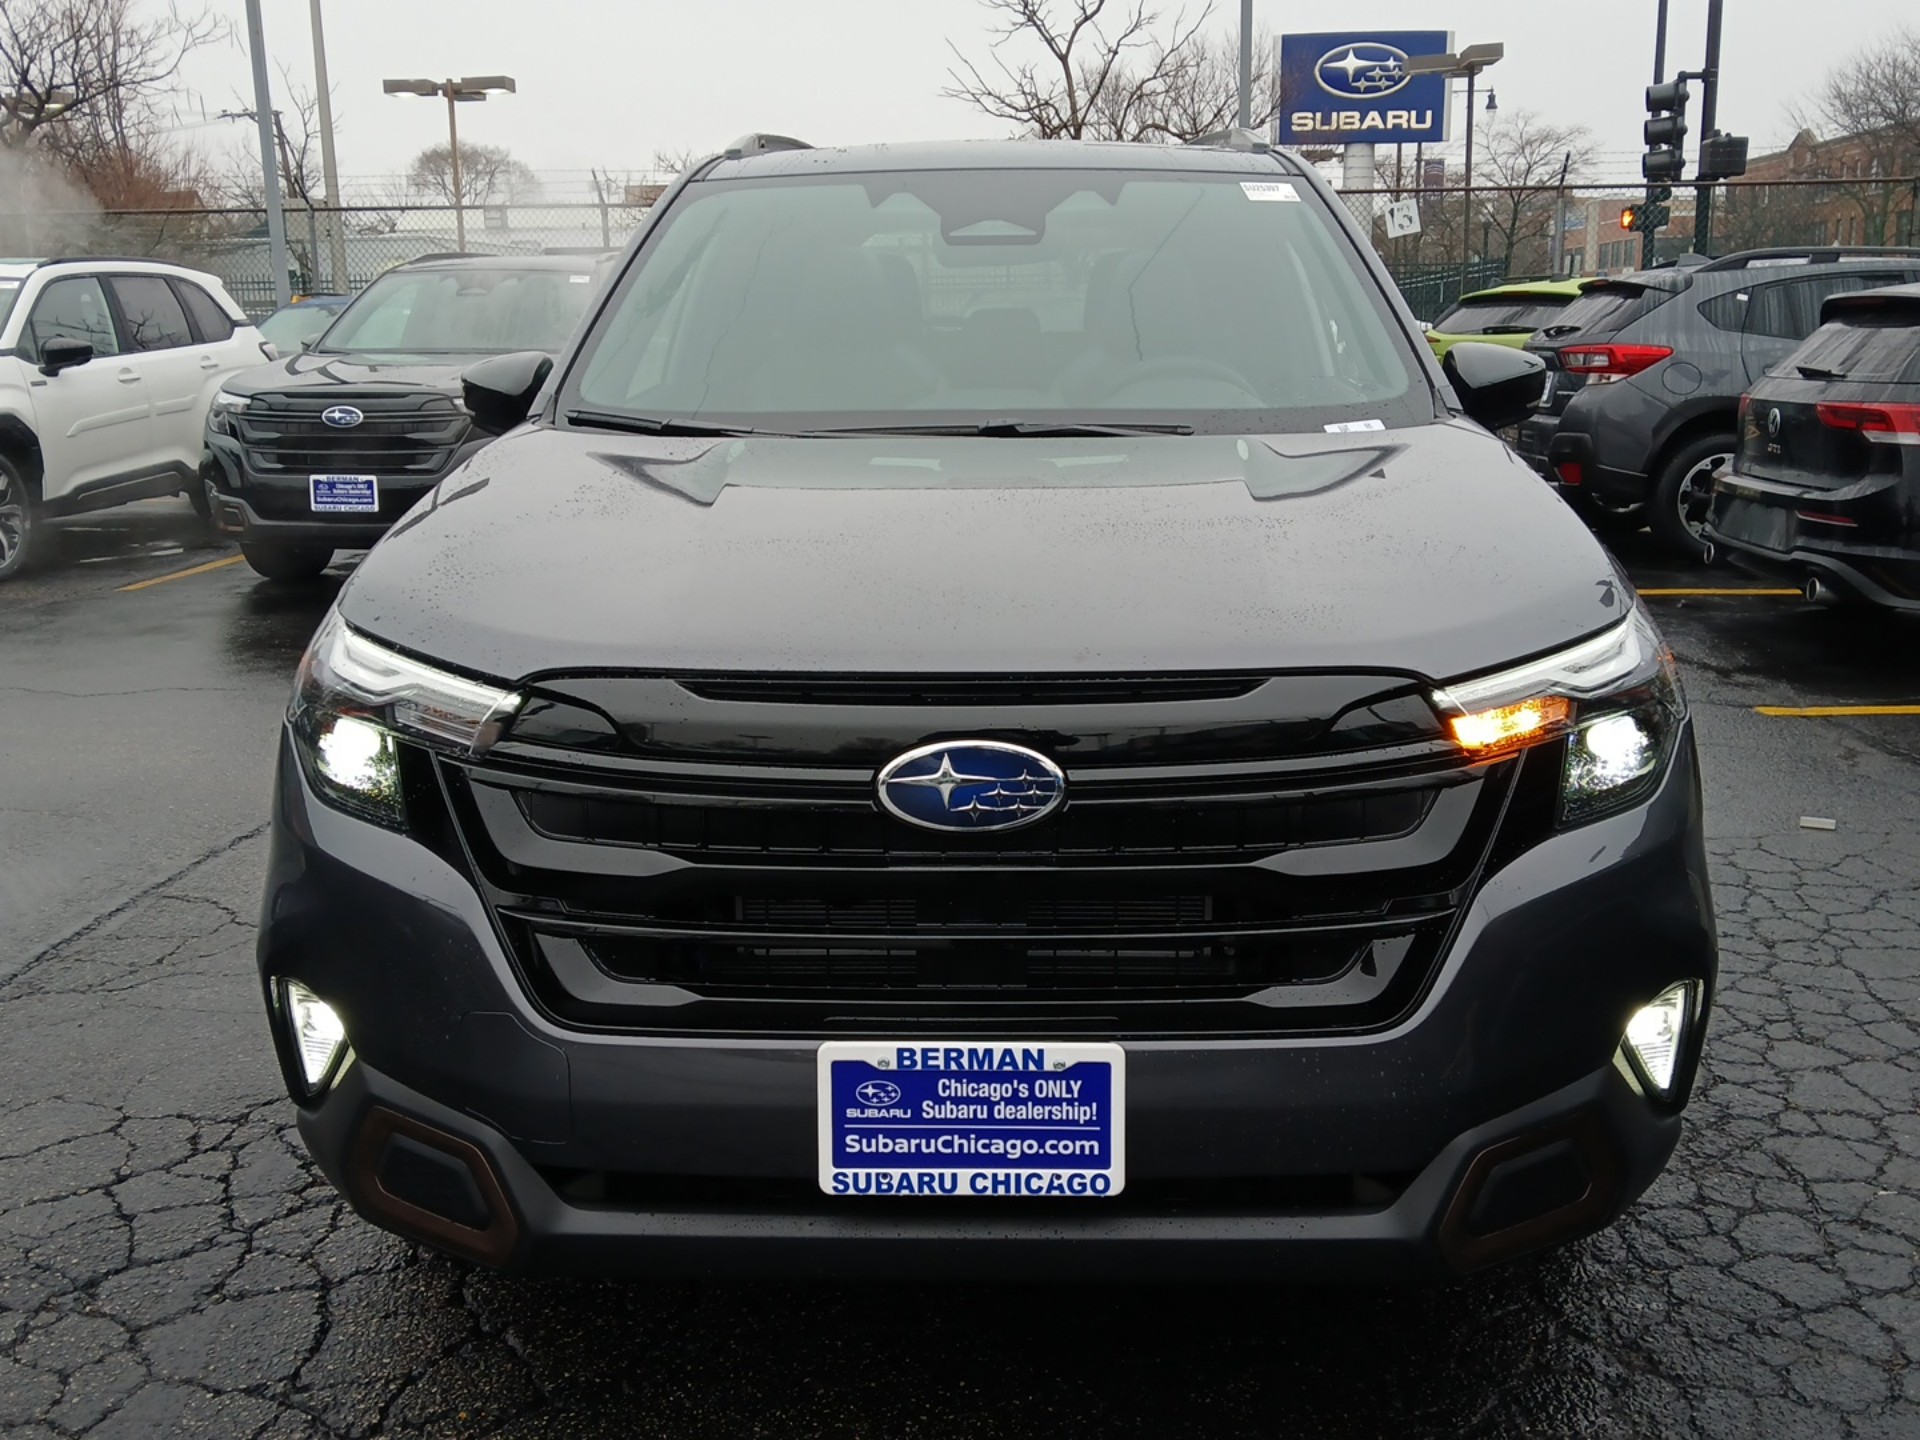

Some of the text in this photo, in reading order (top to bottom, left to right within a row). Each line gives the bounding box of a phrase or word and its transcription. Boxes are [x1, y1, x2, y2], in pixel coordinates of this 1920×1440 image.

[1291, 110, 1432, 131] SUBARU
[896, 1048, 1045, 1071] BERMAN
[938, 1078, 1082, 1101] Chicago's ONLY
[846, 1108, 911, 1118] SUBARU
[922, 1100, 1097, 1124] Subaru dealership!
[844, 1134, 1100, 1159] SubaruChicago.com
[832, 1172, 1111, 1195] SUBARU CHICAGO
